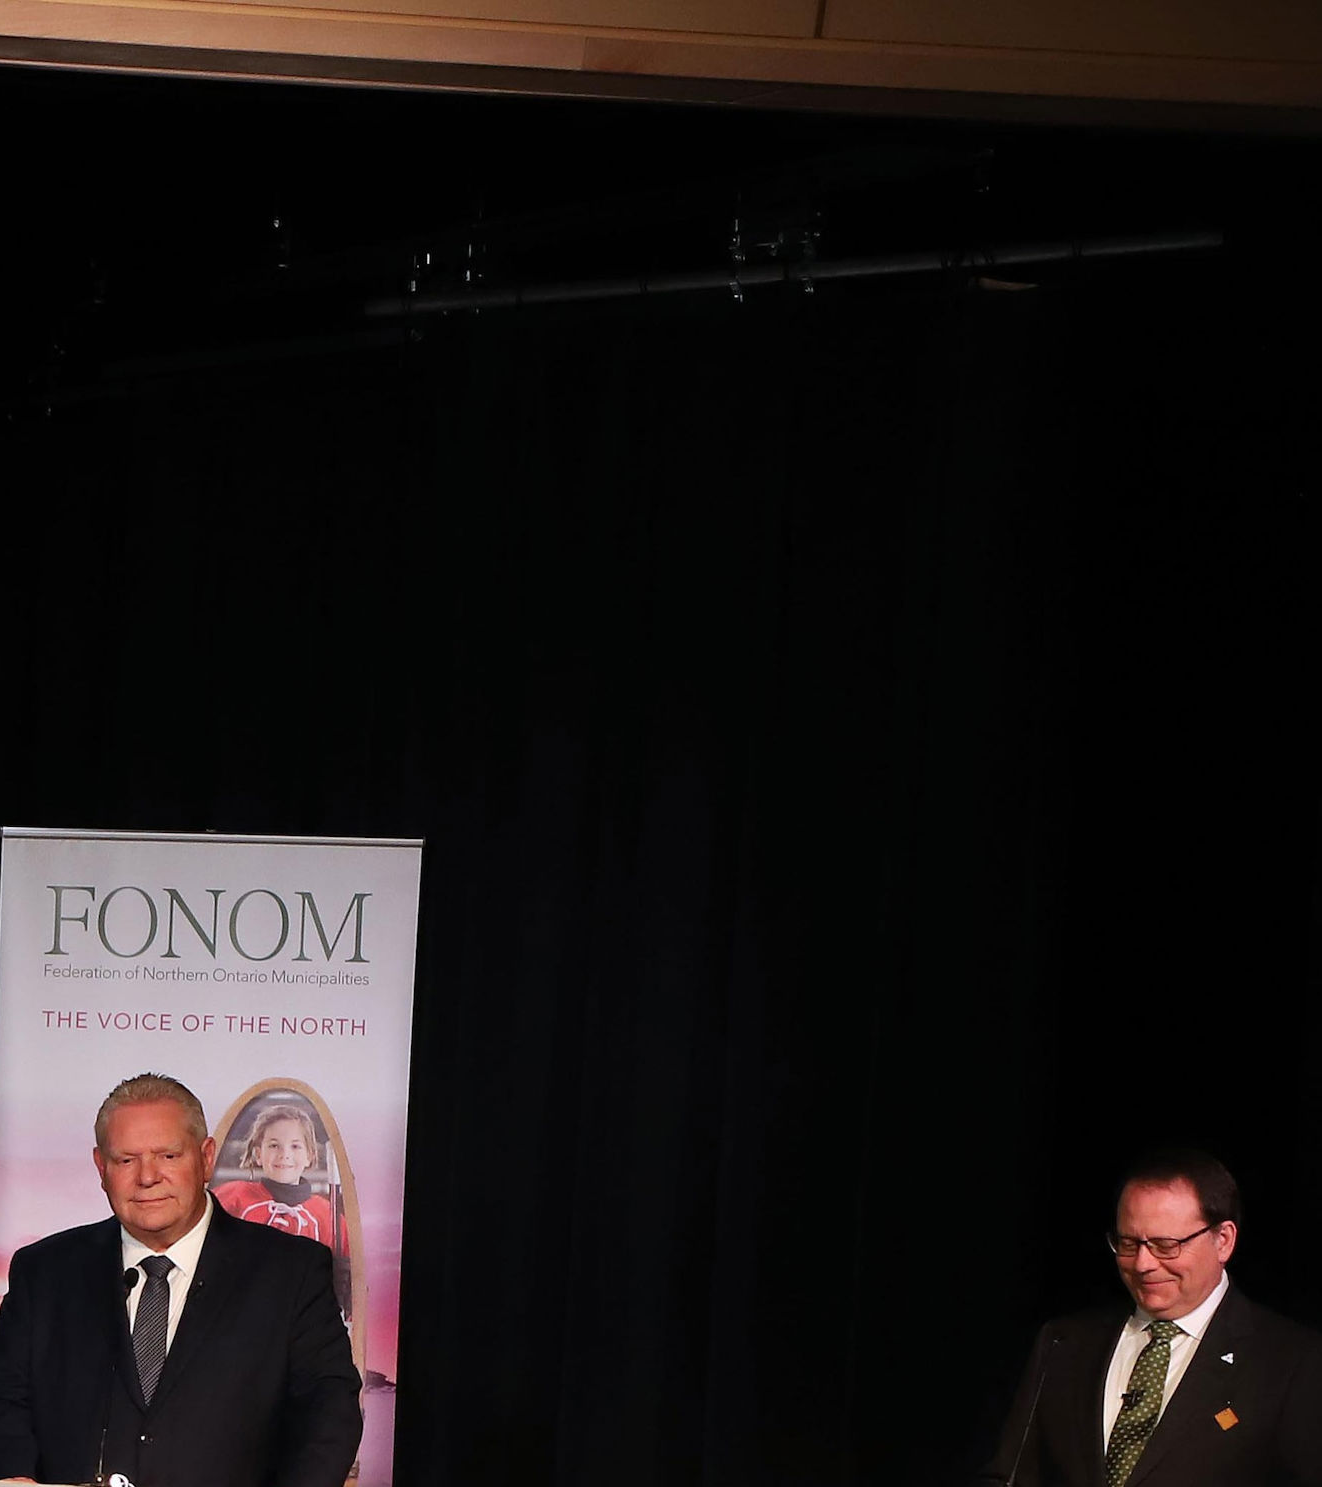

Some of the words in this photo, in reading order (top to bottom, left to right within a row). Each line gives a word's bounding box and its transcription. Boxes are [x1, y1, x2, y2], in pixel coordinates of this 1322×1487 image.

[44, 885, 373, 963] FONOM
[43, 963, 121, 979] Federation
[124, 965, 140, 980] of
[143, 967, 209, 982] Northern
[212, 967, 268, 984] Ontario
[271, 969, 370, 988] Municipalities
[42, 1010, 88, 1029] THE
[97, 1012, 172, 1031] VOICE
[182, 1014, 215, 1032] OF
[224, 1015, 270, 1033] THE
[281, 1017, 366, 1036] NORTH
